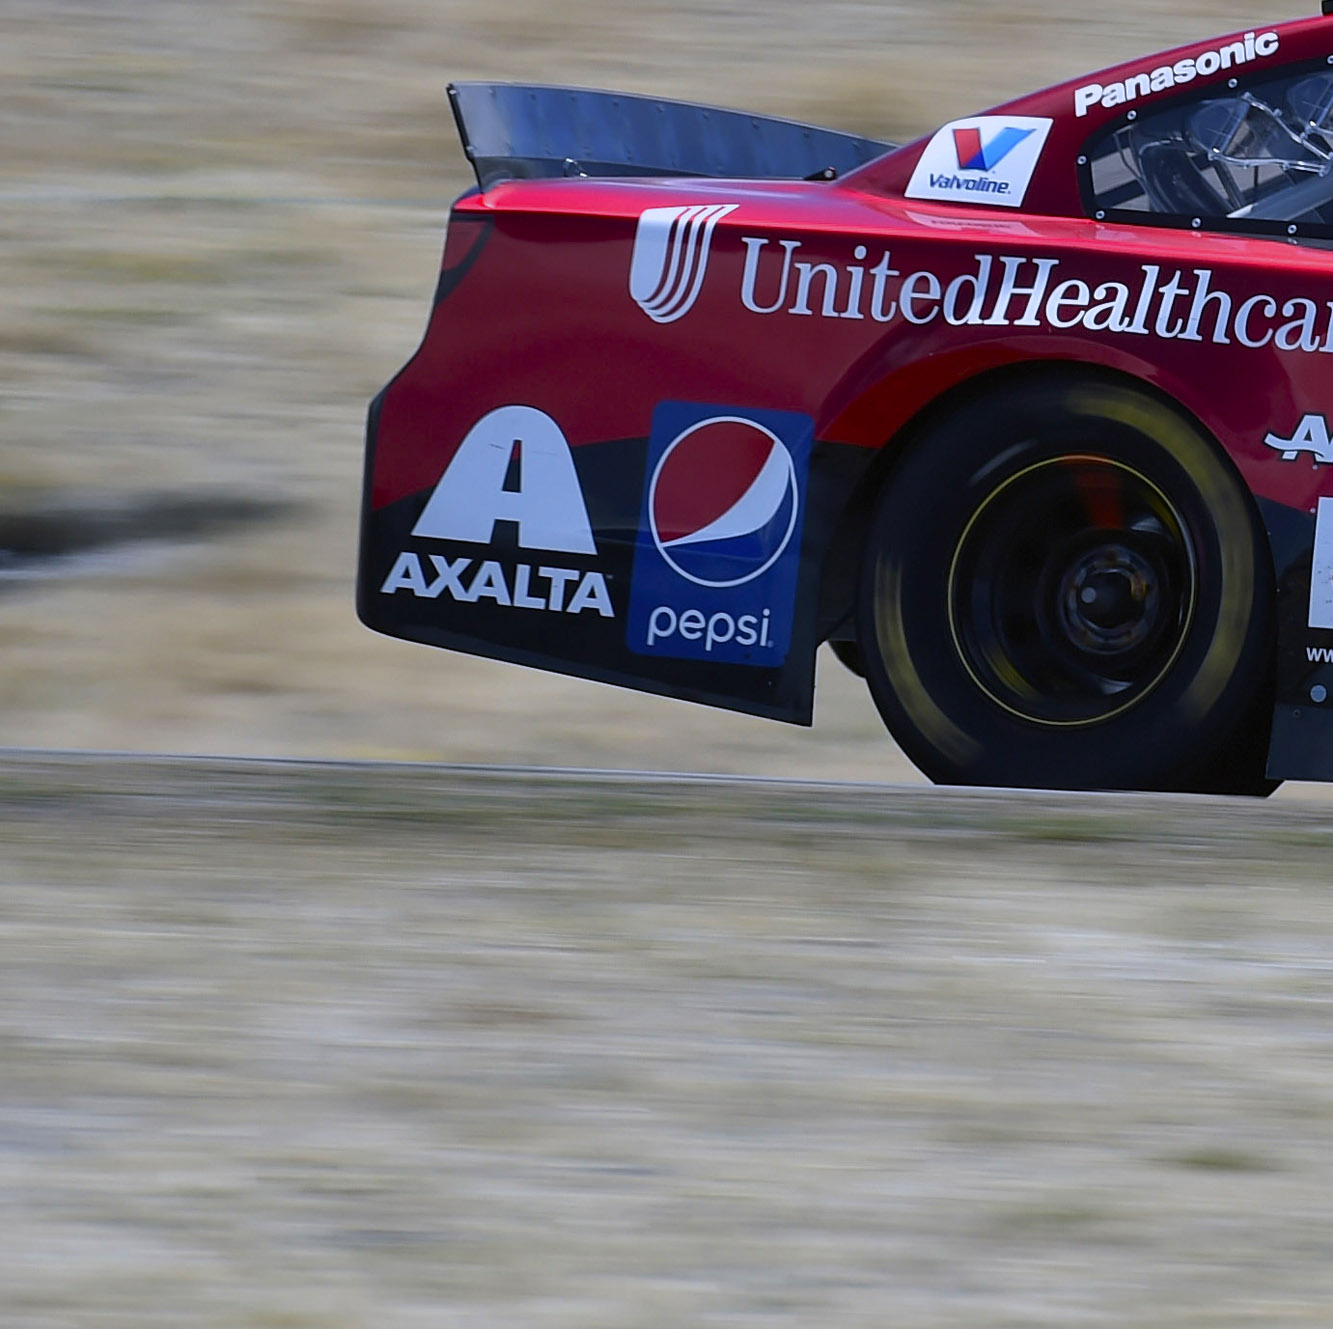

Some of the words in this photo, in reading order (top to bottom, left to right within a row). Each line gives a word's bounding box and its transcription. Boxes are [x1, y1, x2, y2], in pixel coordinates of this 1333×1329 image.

[1074, 31, 1280, 118] Panasonic
[928, 173, 1009, 194] Valvoline
[380, 551, 615, 618] AXALTA
[646, 606, 771, 652] pepsi
